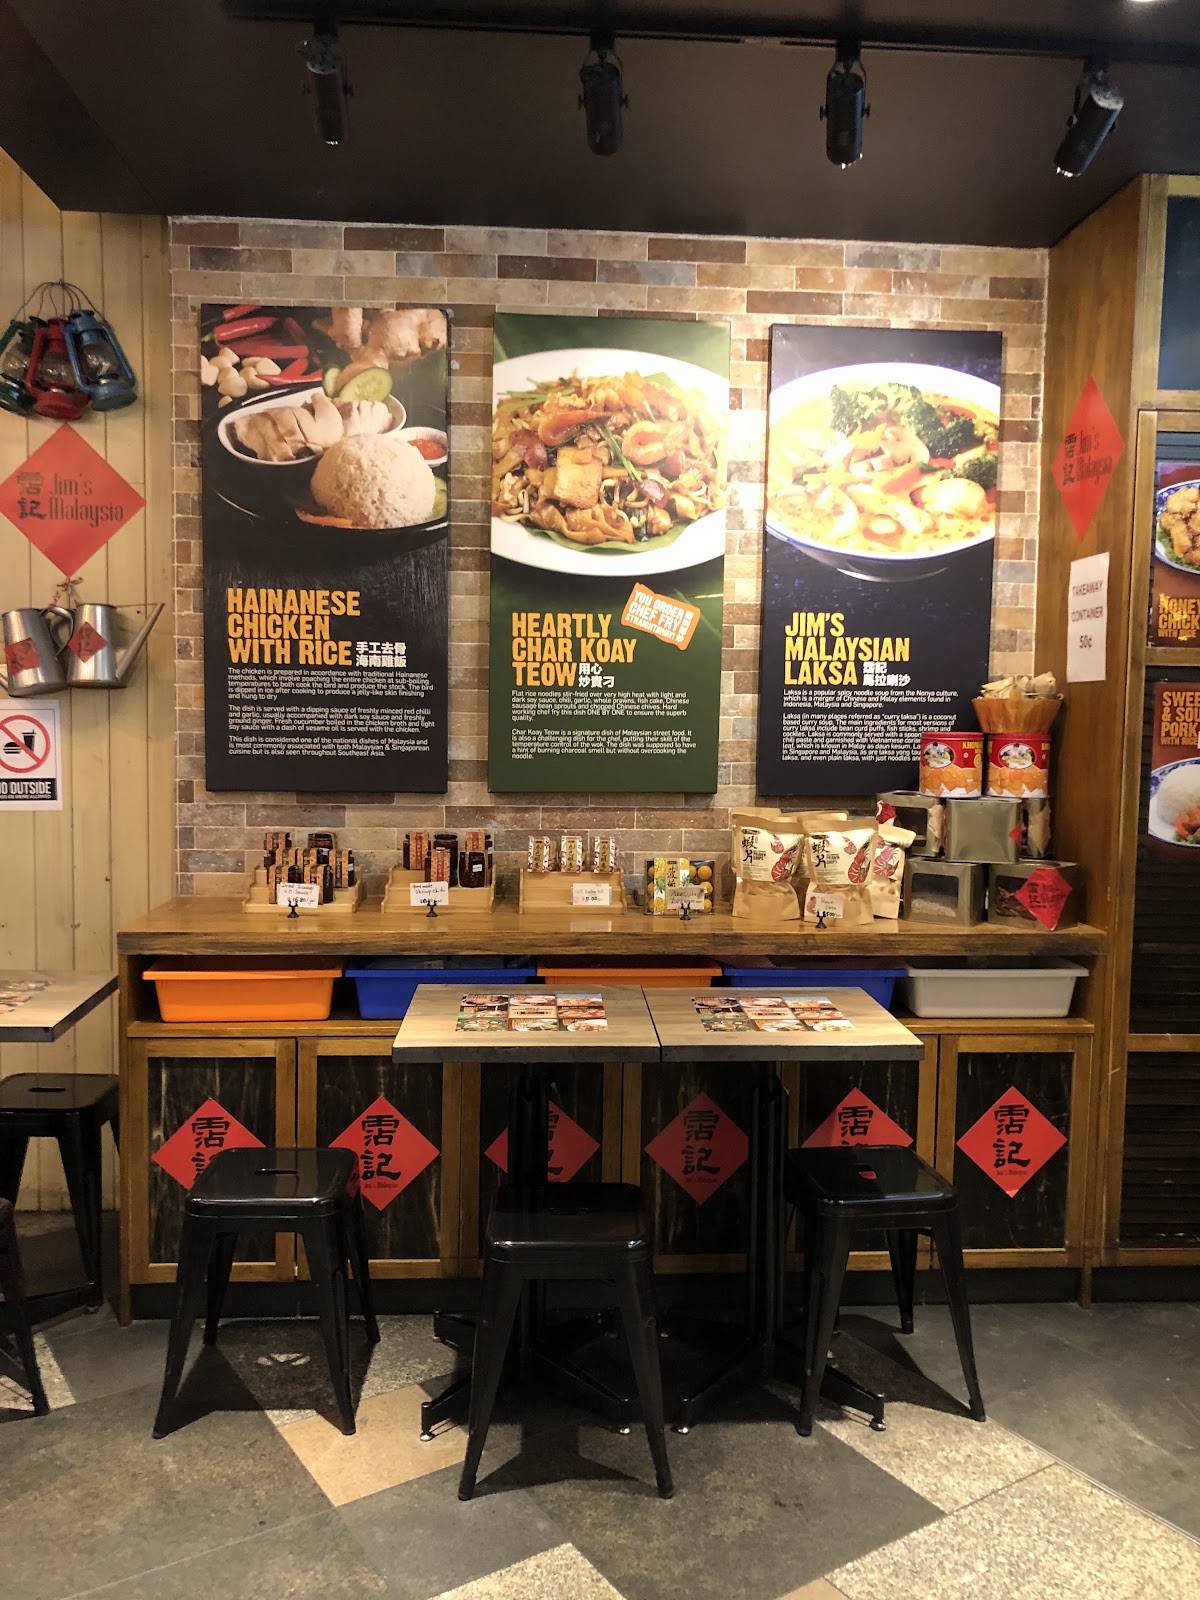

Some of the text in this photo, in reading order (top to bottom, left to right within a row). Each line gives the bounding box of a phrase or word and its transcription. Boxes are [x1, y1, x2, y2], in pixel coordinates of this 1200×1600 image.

[50, 472, 92, 497] Jim's
[49, 497, 124, 528] Malaysia
[1072, 580, 1103, 596] TAKEAWAY
[228, 588, 360, 616] HAINANESE
[635, 590, 684, 619] YOU ORDER
[1072, 606, 1104, 622] CONTAINER
[228, 614, 330, 640] CHICKEN
[512, 612, 612, 638] HEARTLY
[629, 602, 658, 621] CHEF
[658, 614, 681, 632] FRY
[785, 612, 845, 636] JIM'S
[1158, 629, 1178, 637] WITH
[228, 639, 352, 666] WITH RICE
[356, 642, 406, 654] 手工去骨
[512, 638, 637, 662] CHAR KOAY
[785, 637, 910, 661] MALAYSIAN
[273, 669, 302, 677] prepared
[512, 662, 577, 686] TEOW
[579, 663, 602, 675] 用心
[785, 661, 857, 685] LAKSA
[1162, 706, 1172, 722] &
[1161, 721, 1197, 737] PORK
[10, 782, 52, 794] OUTSIDE
[361, 1114, 402, 1181] 霑記
[681, 1110, 720, 1176] 霑記
[993, 1104, 1031, 1169] 霑記
